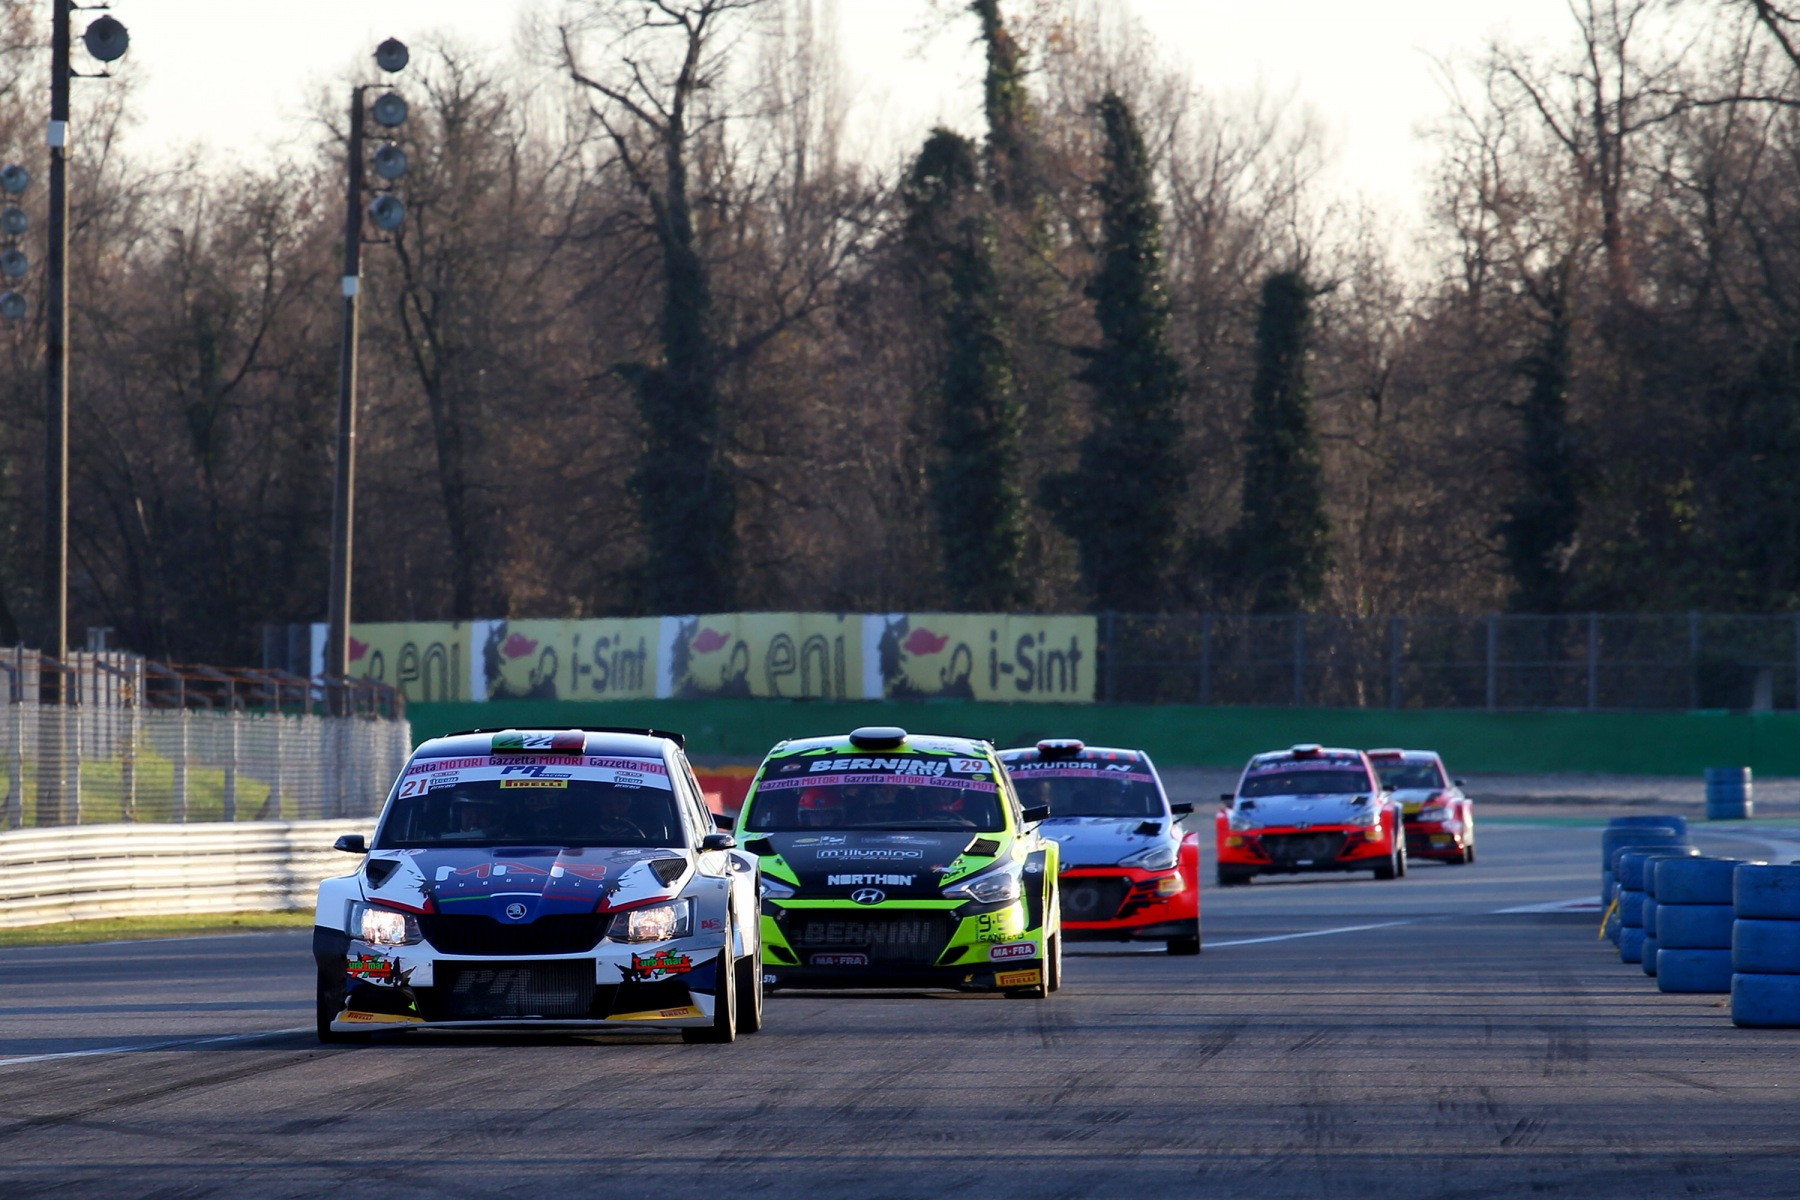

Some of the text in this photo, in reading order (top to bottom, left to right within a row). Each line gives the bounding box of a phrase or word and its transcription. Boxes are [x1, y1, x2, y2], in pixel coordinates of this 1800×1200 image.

[571, 633, 648, 692] i-Sint
[765, 614, 846, 698] eni
[988, 629, 1084, 693] i-Sint
[440, 758, 482, 769] MOTORI
[489, 756, 536, 766] Gazzetta
[539, 756, 583, 765] MOTORI
[590, 757, 637, 769] Gazzetta
[809, 758, 948, 772] BERNINI
[960, 760, 983, 772] 29
[1020, 761, 1097, 770] HYUNDAI
[400, 779, 428, 798] 21
[760, 780, 799, 790] Gazzetta
[844, 775, 884, 783] Gazzetta
[887, 775, 924, 784] MOTORI
[930, 778, 970, 788] Gazzetta
